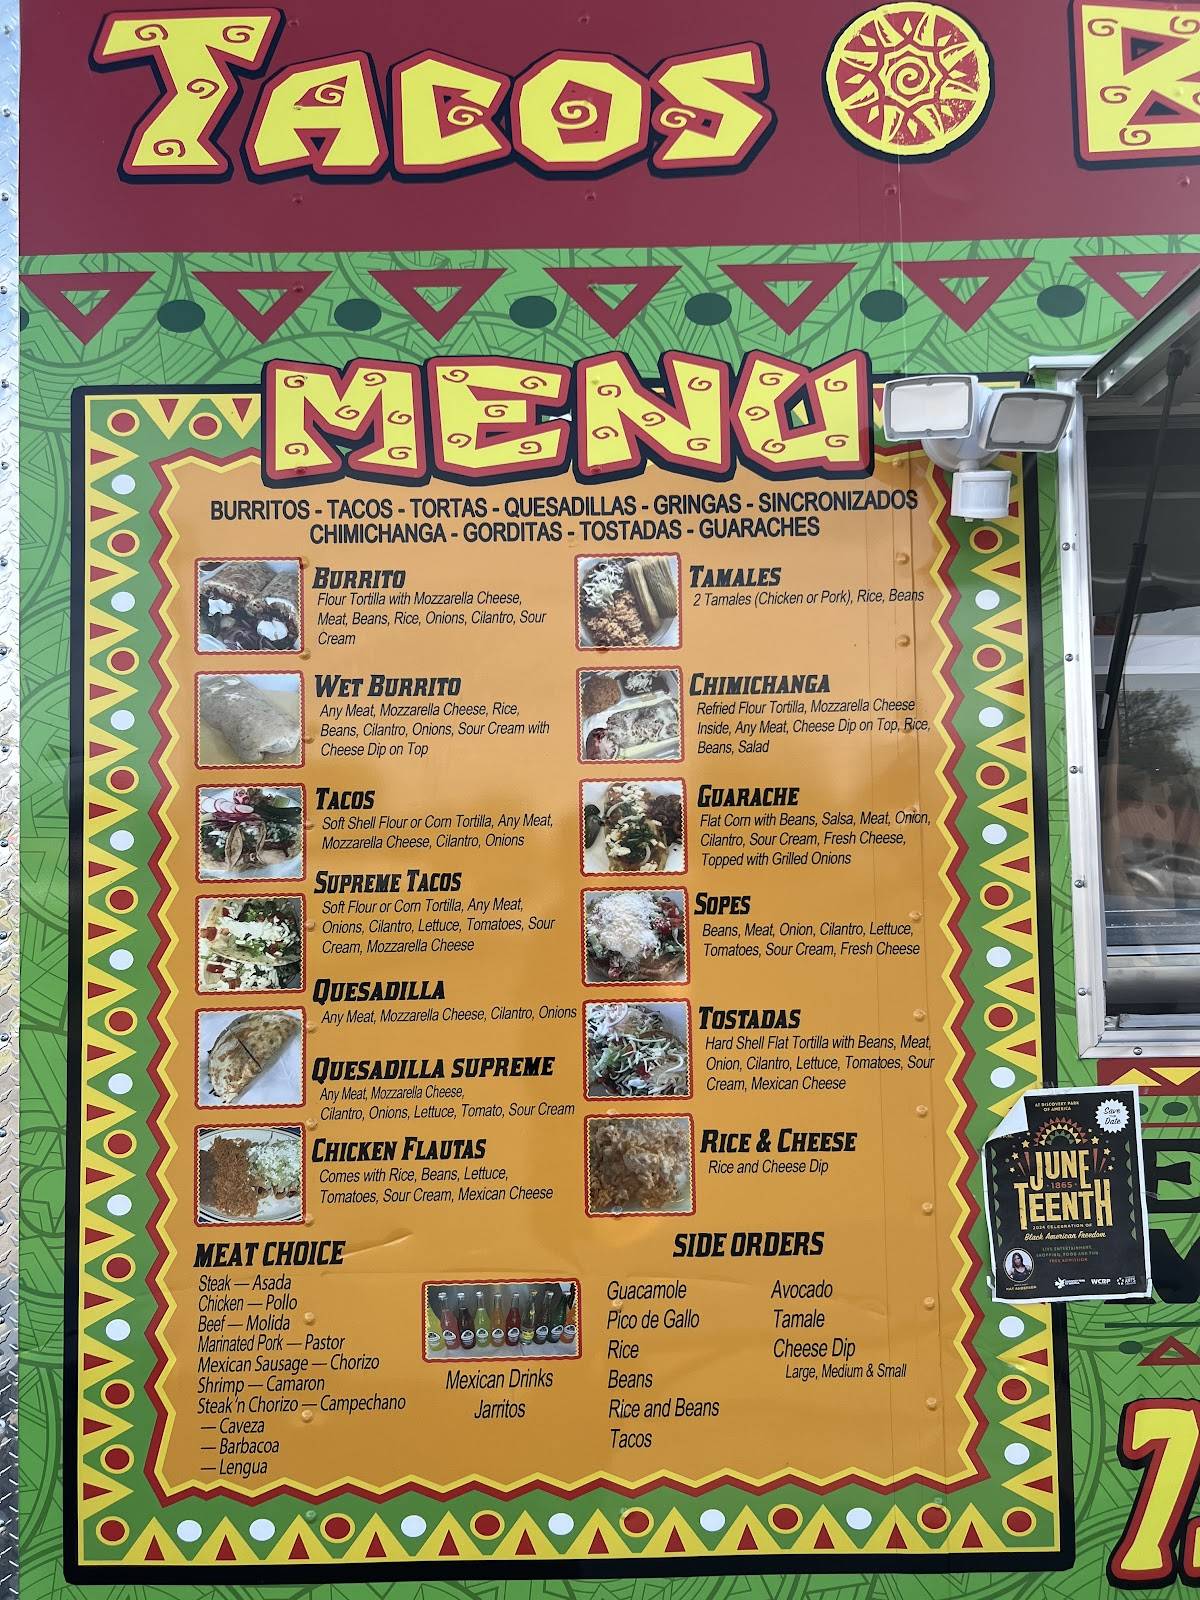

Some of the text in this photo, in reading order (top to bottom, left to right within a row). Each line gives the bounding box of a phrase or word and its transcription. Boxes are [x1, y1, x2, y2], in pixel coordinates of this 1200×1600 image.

[91, 7, 768, 176] TACOS
[262, 350, 873, 478] MENU
[211, 490, 918, 520] BURRITOS TACOS TORTAS QUESADILLAS GRINGAS SINCRONIZADOS
[310, 517, 820, 544] CHIMICHANGA GORDITAS TOSTADAS GUARACHES
[317, 590, 522, 606] Flour Tortilla with Mozzarella Cheese,
[693, 587, 925, 608] 2 Tamales (Chicken or Pork), Rice, Beans
[321, 742, 429, 759] Cheese Dip on Top
[697, 739, 770, 755] Beans, Salad
[322, 833, 525, 850] Mozzarella Cheese, Cilantro, Onions
[702, 851, 852, 869] Topped with Grilled Onions
[322, 938, 475, 956] Cream, Mozzarella Cheese
[320, 1005, 577, 1026] Any Meat, Mozzarella Cheese, Cilantro, Onions
[706, 1076, 846, 1092] Cream, Mexican Cheese
[320, 1102, 575, 1122] Cilantro, Onions, Lettuce, Tomato, Sour Cream
[1104, 1107, 1121, 1115] Save
[1104, 1117, 1122, 1125] Date
[756, 1128, 772, 1153] &
[708, 1158, 829, 1176] Rice and Cheese Dip
[1029, 1150, 1091, 1191] JUNE
[320, 1185, 554, 1205] Tomatoes, Sour Cream, Mexican Cheese
[1013, 1178, 1113, 1230] TEENTH
[672, 1231, 825, 1258] SIDE ORDERS
[1024, 1230, 1106, 1241] Black American Freedom
[192, 1240, 346, 1268] MEAT CHOICE
[198, 1273, 292, 1292] Steak Asada
[607, 1280, 687, 1301] Guacamole
[770, 1279, 833, 1299] Avocado
[198, 1293, 298, 1312] Chicken Pollo
[198, 1313, 290, 1332] Beef Molida
[606, 1308, 700, 1330] Pico de Gallo
[773, 1308, 825, 1328] Tamale
[257, 1333, 284, 1351] Pork
[304, 1333, 346, 1350] Pastor
[608, 1339, 639, 1359] Rice
[773, 1337, 856, 1359] Cheese Dip
[197, 1352, 380, 1374] Mexican Sausage Chorizo
[785, 1362, 907, 1382] Large, Medium & Small
[197, 1373, 325, 1395] Shrimp Camaron
[446, 1368, 554, 1390] Mexican Drinks
[608, 1369, 653, 1389] Beans
[248, 1395, 298, 1413] Chorizo
[320, 1393, 406, 1415] Campechano
[474, 1398, 526, 1419] Jarritos
[608, 1397, 720, 1418] Rice and Beans
[220, 1417, 265, 1434] Caveza
[219, 1436, 280, 1455] Barbacoa
[610, 1428, 652, 1448] Tacos
[219, 1458, 268, 1479] Lengua
